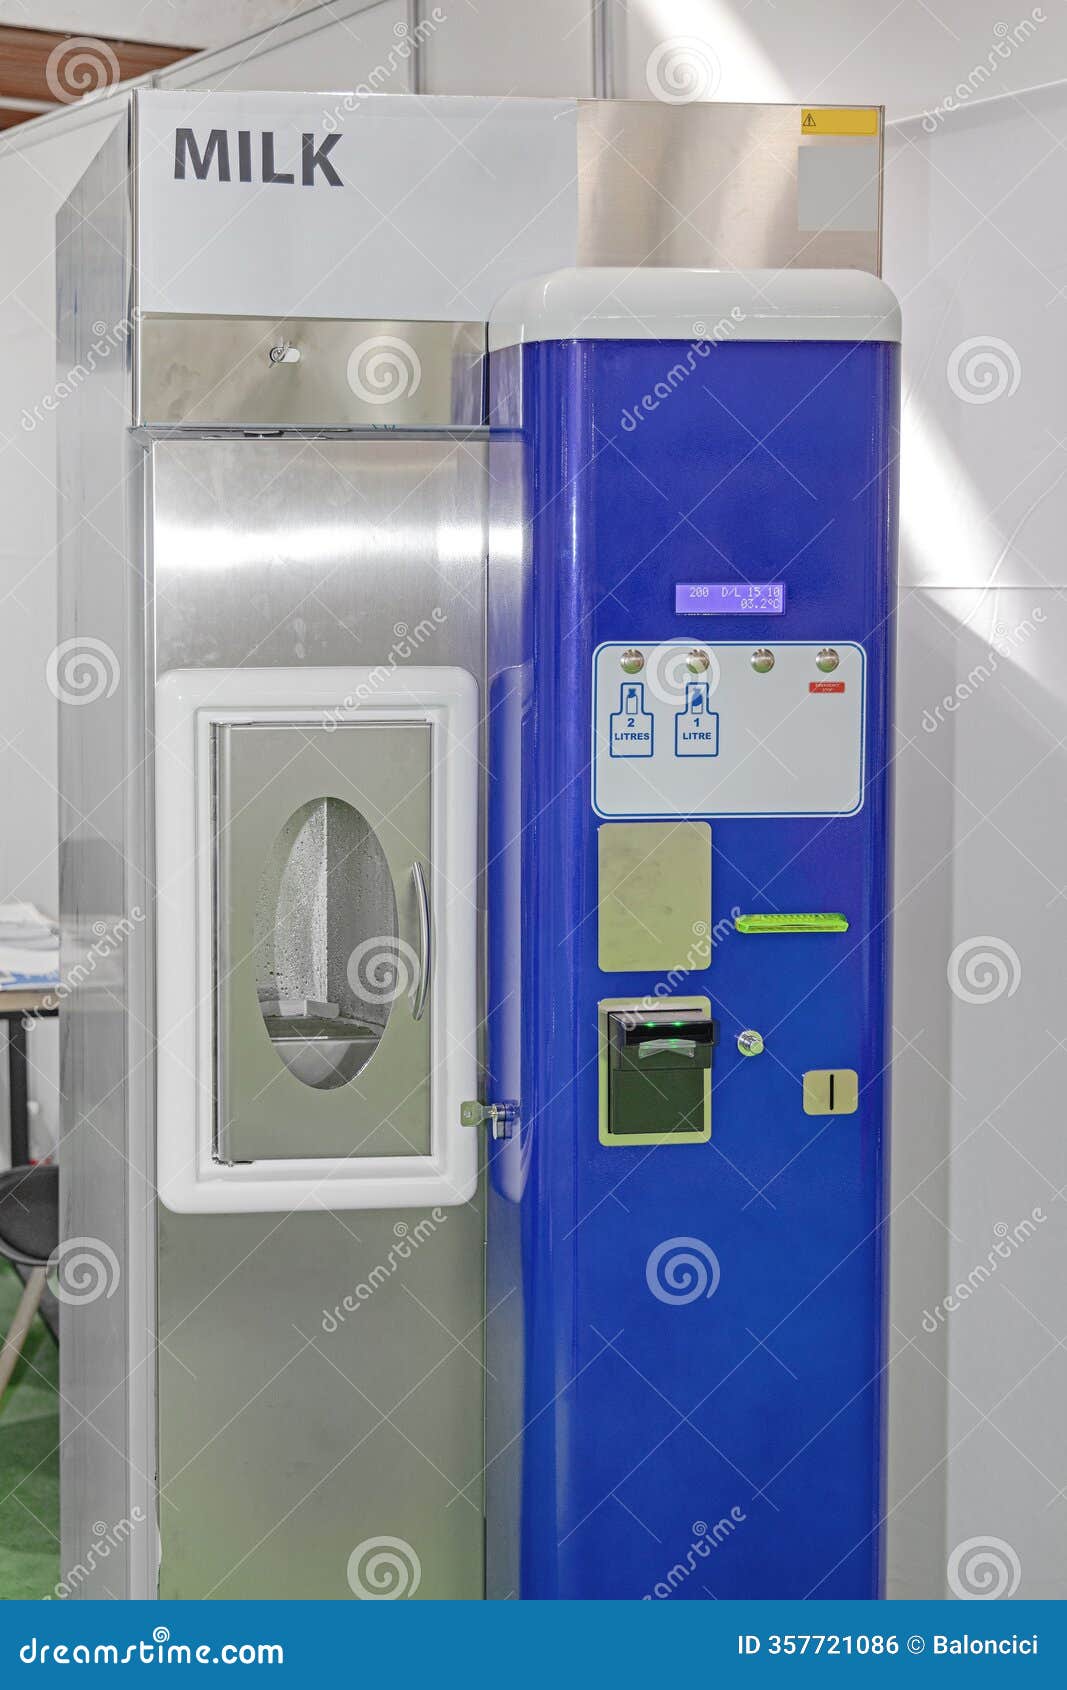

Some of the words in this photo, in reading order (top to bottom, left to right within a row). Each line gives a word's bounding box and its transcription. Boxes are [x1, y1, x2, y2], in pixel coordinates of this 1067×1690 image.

[174, 127, 344, 187] MILK
[689, 586, 709, 598] 200
[721, 586, 741, 598] D/L
[627, 718, 635, 728] 2
[693, 718, 700, 728] 1
[614, 732, 650, 741] LITRES
[682, 732, 712, 740] LITRE
